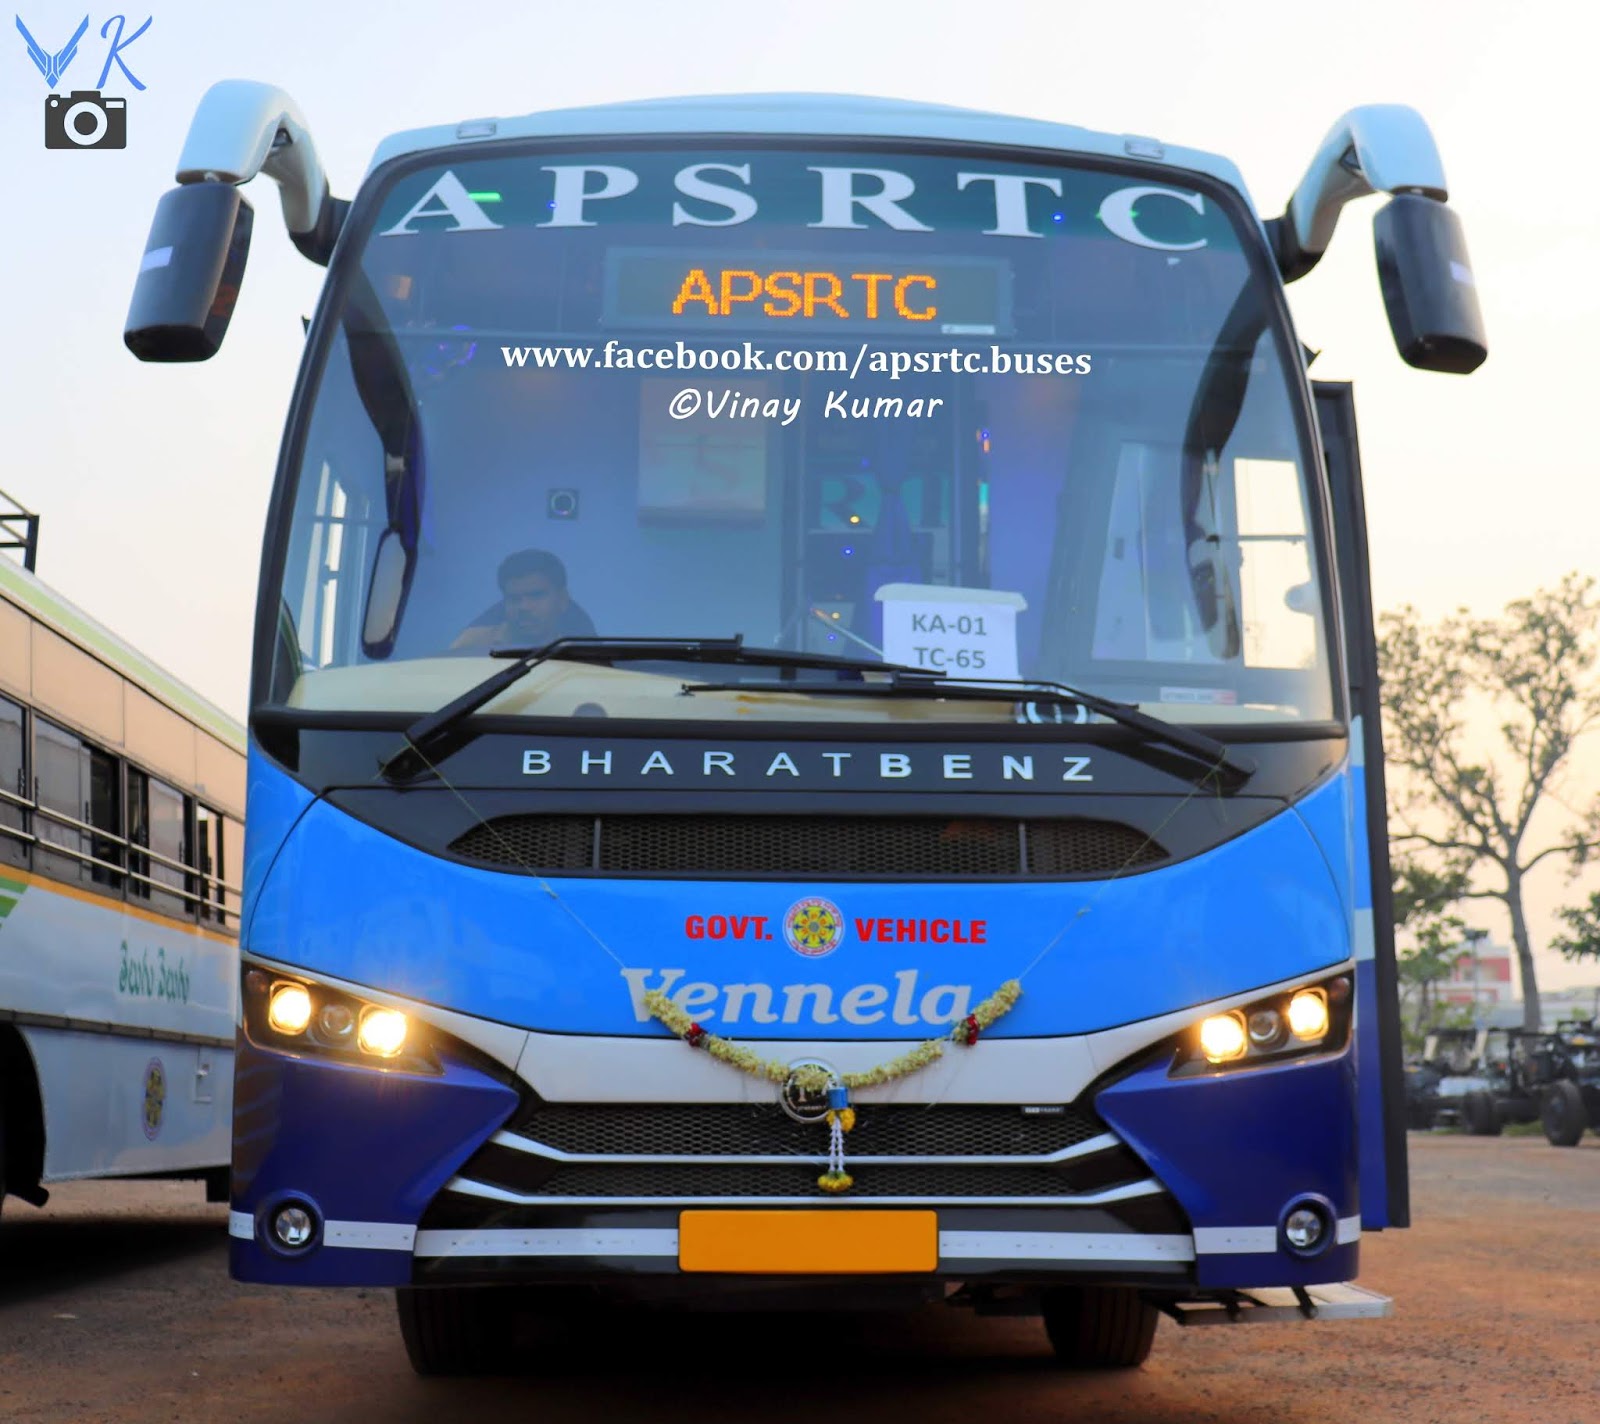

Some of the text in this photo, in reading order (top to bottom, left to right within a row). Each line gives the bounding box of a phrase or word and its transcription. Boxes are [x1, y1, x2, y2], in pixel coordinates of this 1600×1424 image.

[379, 162, 1209, 252] APSRTC
[672, 269, 938, 322] APSRTC
[911, 613, 987, 637] KA-01
[912, 646, 987, 669] TC-65
[521, 749, 1094, 782] BHARATBENZ
[685, 915, 773, 940] GOVT.
[854, 918, 988, 944] VEHICLE
[620, 967, 974, 1026] Vennela
